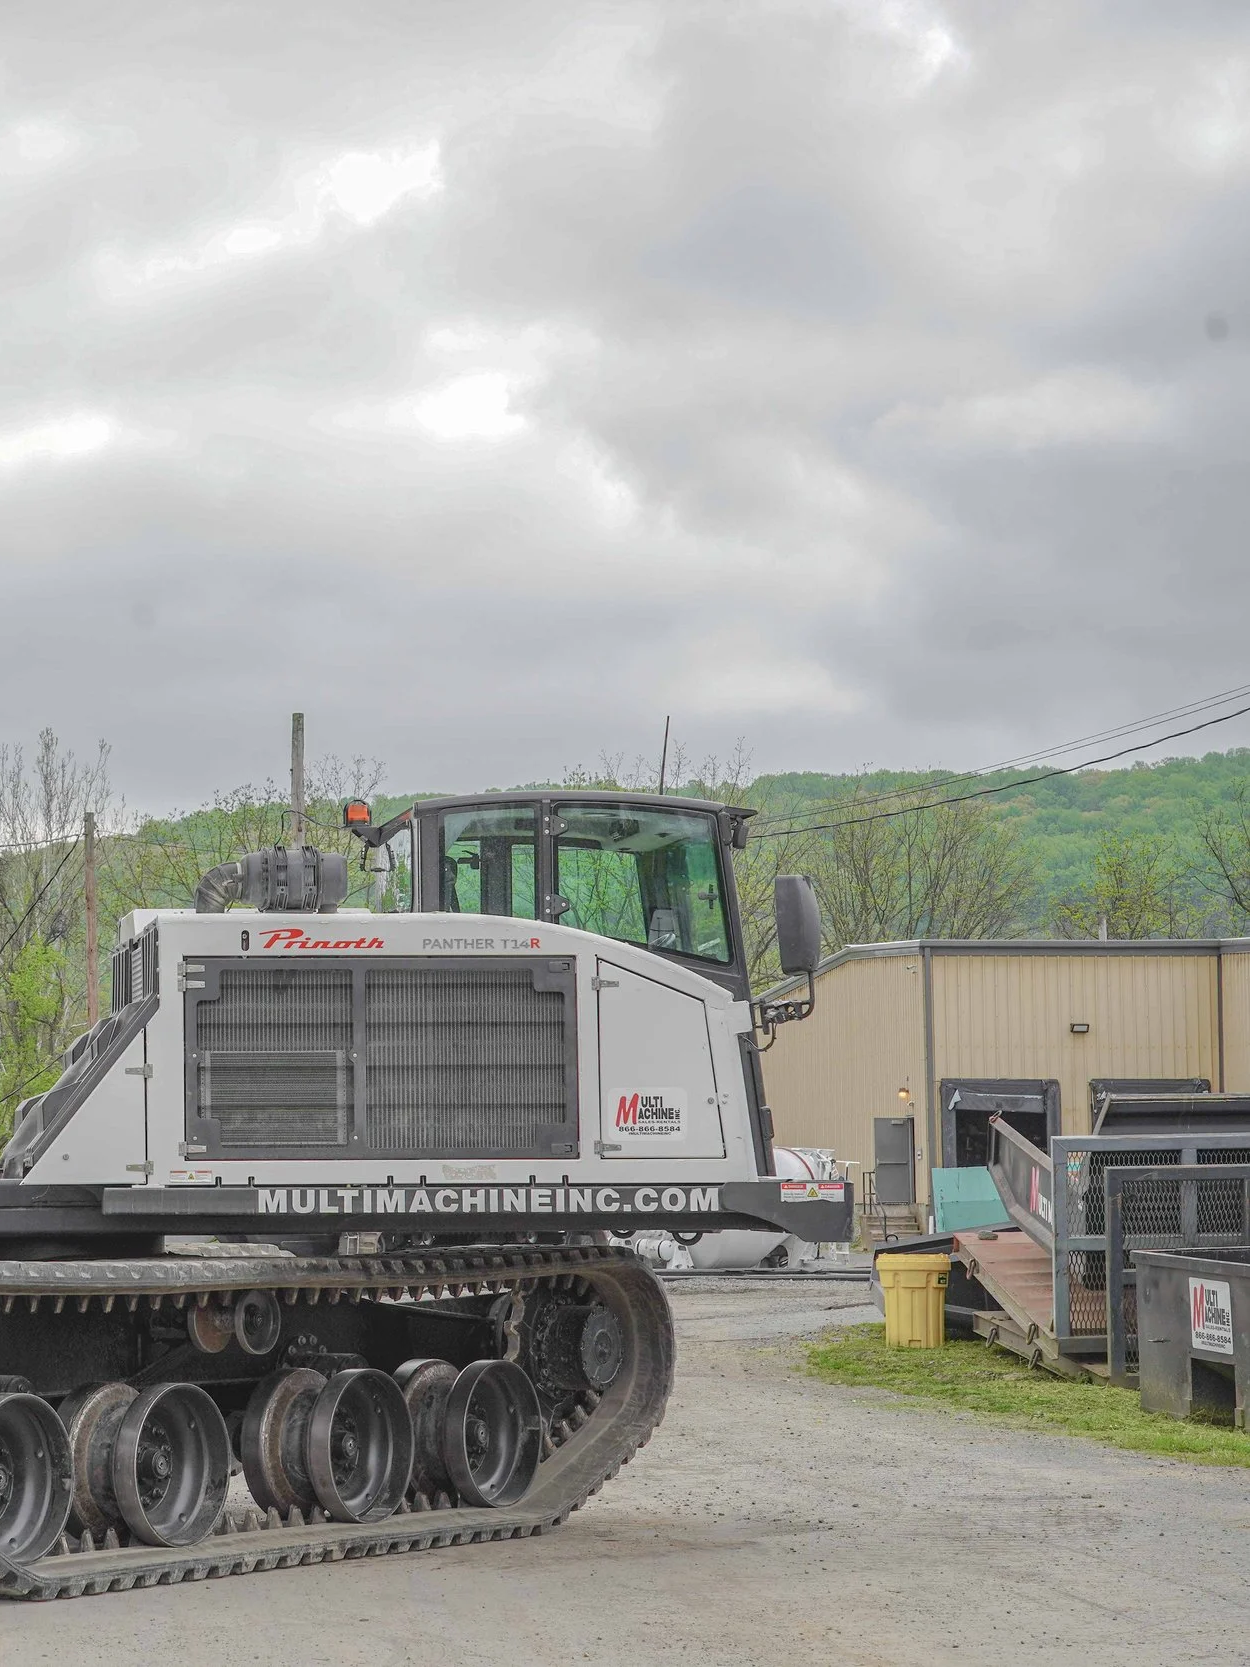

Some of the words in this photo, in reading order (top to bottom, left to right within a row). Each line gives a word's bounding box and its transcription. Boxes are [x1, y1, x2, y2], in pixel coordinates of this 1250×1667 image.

[259, 928, 385, 949] Prinoth
[422, 938, 495, 949] PANTHER
[500, 938, 541, 949] T14R
[258, 1187, 720, 1214] MULTIMACHINEINC.COM
[1195, 1331, 1232, 1344] 866-866-8584
